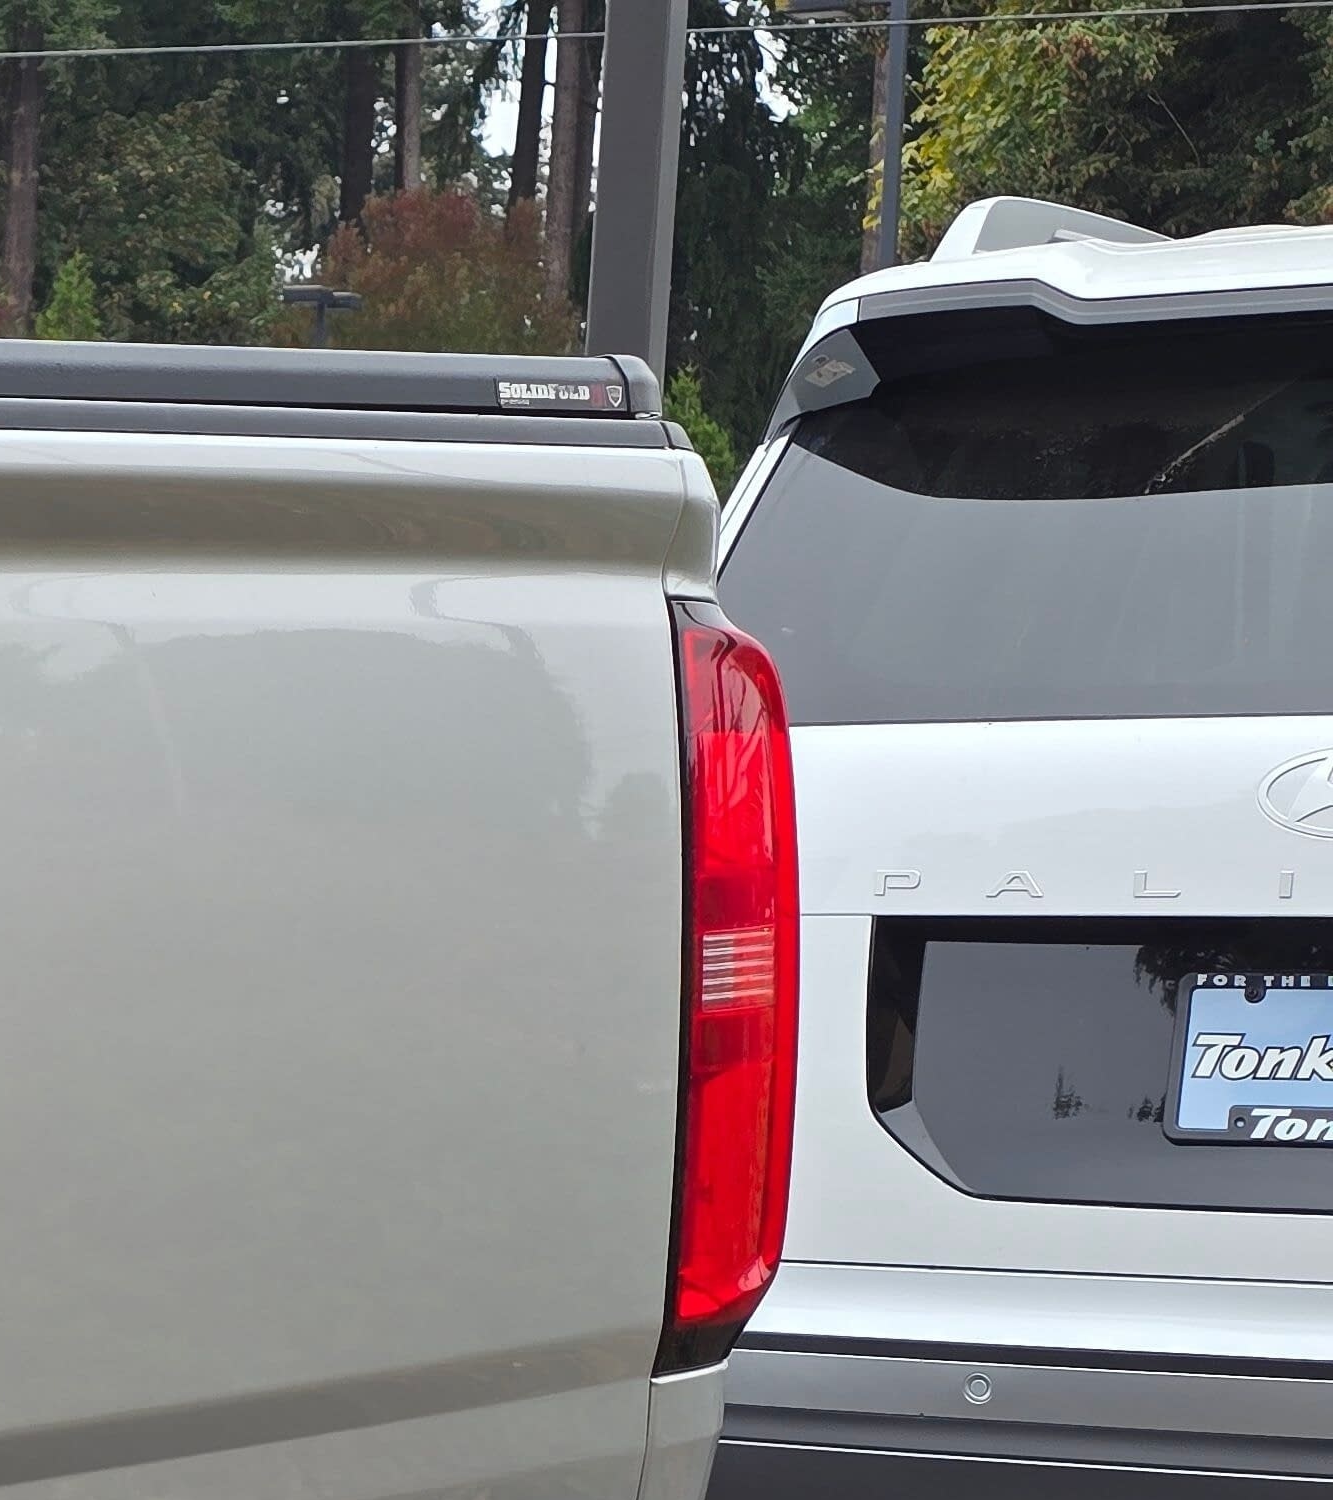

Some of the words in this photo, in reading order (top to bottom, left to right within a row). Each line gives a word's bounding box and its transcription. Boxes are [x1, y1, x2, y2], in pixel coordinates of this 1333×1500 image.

[873, 869, 1295, 899] PALI
[1196, 973, 1247, 987] FOR
[1263, 975, 1311, 987] THE
